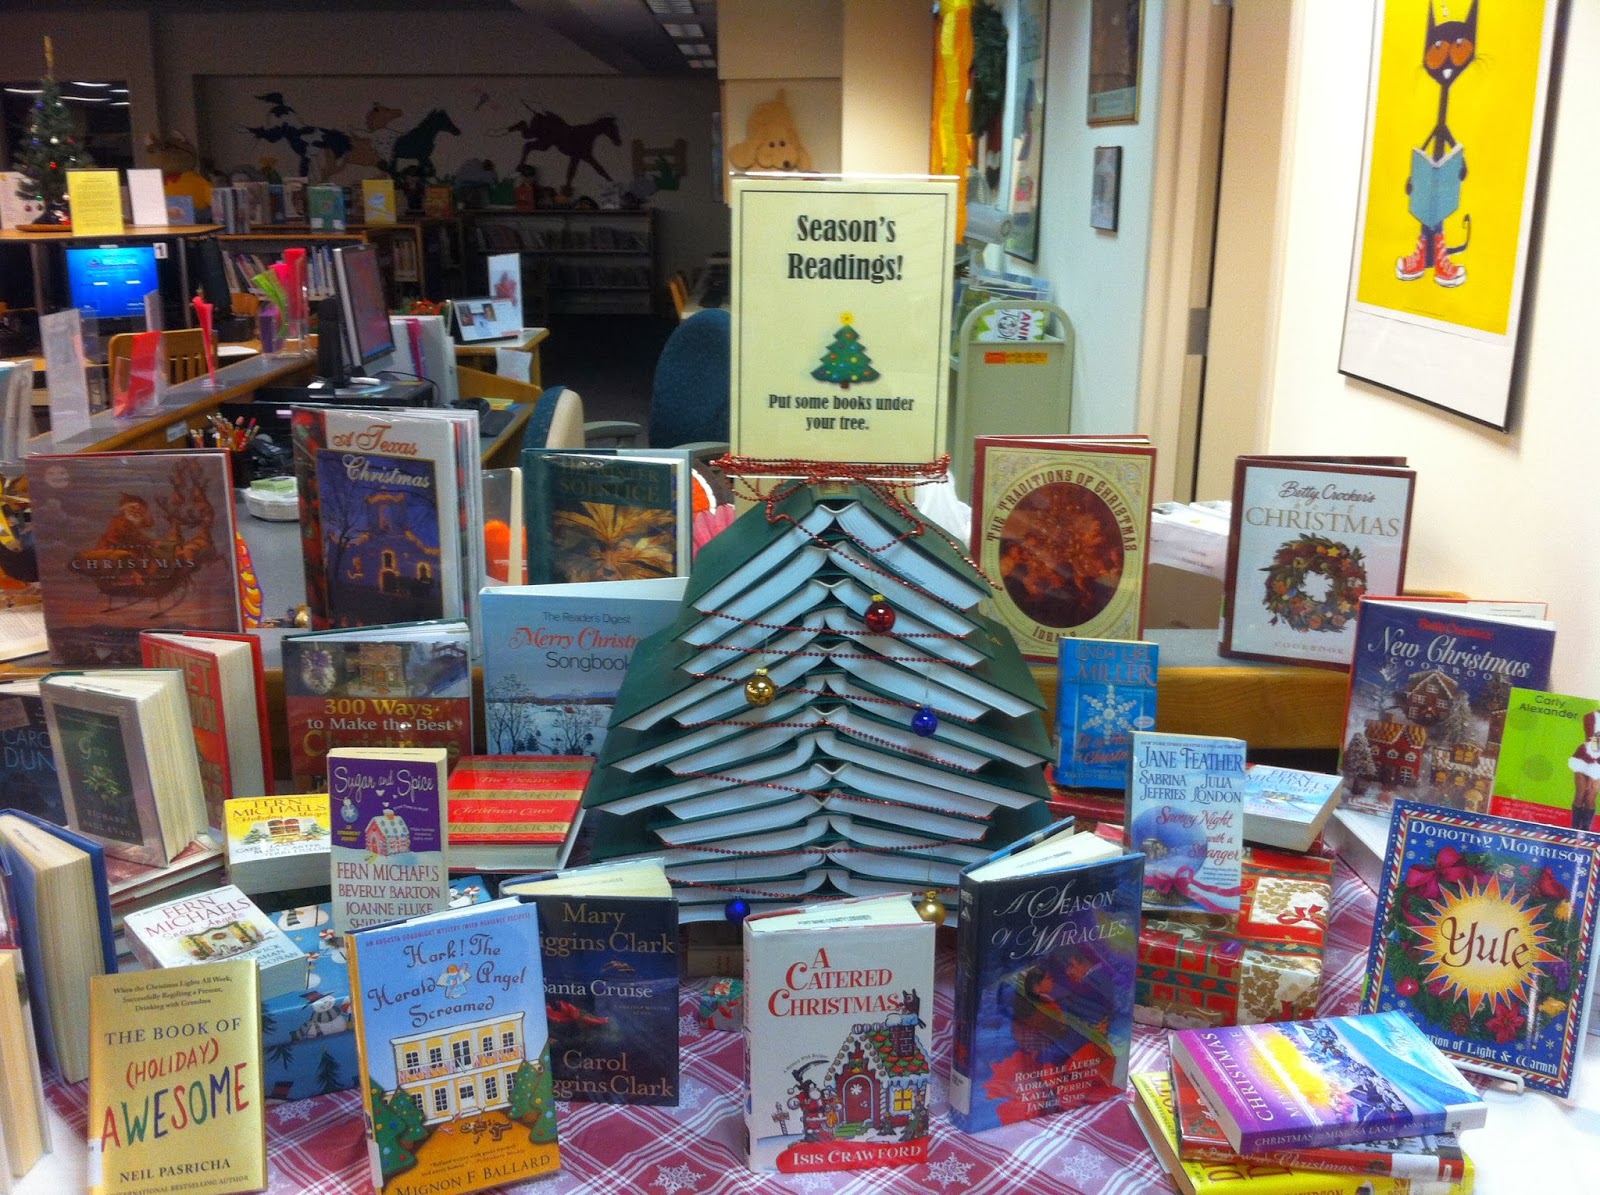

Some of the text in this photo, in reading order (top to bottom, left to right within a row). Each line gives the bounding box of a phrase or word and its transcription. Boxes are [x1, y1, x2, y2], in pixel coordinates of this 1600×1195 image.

[797, 214, 897, 243] Season's
[787, 253, 904, 284] Readings!
[768, 394, 914, 411] Put some books under
[805, 415, 869, 431] your tree.
[332, 424, 418, 455] A Texas
[341, 453, 431, 489] Christmas
[1278, 480, 1320, 506] Betty
[985, 469, 1139, 552] THE TRADITIONS OF CHRISTMAS
[1245, 506, 1400, 537] CHRISTMAS
[71, 557, 196, 570] CHRISTMAS
[543, 611, 560, 622] The
[603, 612, 632, 625] Digest
[508, 626, 642, 651] Merry Christm
[546, 652, 631, 673] Songbook
[1367, 626, 1531, 679] New Christmas
[1075, 663, 1158, 687] MILLER
[324, 698, 433, 720] 300 Ways
[1518, 702, 1579, 720] Alexander
[1534, 694, 1567, 709] Carly
[307, 718, 454, 732] to Make the Best
[2, 728, 52, 749] CARO
[4, 746, 59, 772] DUN
[1139, 746, 1178, 769] JANE
[1180, 747, 1245, 773] FEATHER
[334, 766, 435, 803] Sugar and Spice
[1139, 770, 1188, 787] SABRINA
[1200, 774, 1233, 789] JULIA
[254, 798, 302, 808] FERN
[1139, 784, 1187, 801] JEFFRIES
[1190, 786, 1242, 805] LONDON
[232, 804, 328, 818] MICHAELS
[1156, 805, 1234, 831] Snowy Night
[1206, 832, 1225, 845] with
[1495, 836, 1592, 865] MORRISON
[1188, 842, 1239, 866] Stranger
[337, 861, 440, 882] FERN MICHAELS
[338, 883, 441, 900] BEVERLY BARTON
[992, 890, 1036, 917] A
[1027, 878, 1119, 919] SEASON
[145, 898, 251, 938] MICHAELS
[161, 895, 216, 919] FERN
[345, 901, 434, 917] JOANNE FLUKE
[562, 902, 626, 932] Mary
[349, 917, 394, 929] SHIR
[403, 933, 502, 969] Hark! The
[540, 932, 676, 957] iggins Clark
[1009, 918, 1127, 960] MIRACLES
[1440, 916, 1531, 970] Yule
[811, 947, 831, 969] A
[113, 985, 133, 995] When
[145, 981, 179, 993] Christmas
[180, 979, 200, 990] Lights
[200, 977, 212, 986] All
[212, 975, 233, 985] Work,
[367, 960, 527, 1012] Herald Angel
[541, 977, 654, 999] Santa Cruise
[785, 961, 893, 991] CATERED
[165, 1001, 180, 1010] with
[409, 996, 495, 1028] Screamed
[768, 987, 900, 1018] CHRISTMAS
[104, 1017, 242, 1046] THE BOOK OF
[126, 1037, 220, 1090] (HOLIDAY)
[563, 1049, 628, 1073] Carol
[1452, 1038, 1464, 1052] of
[1467, 1042, 1497, 1061] Light
[1515, 1055, 1559, 1076] Warmth
[1013, 1064, 1067, 1083] ROCHELLE
[1015, 1067, 1098, 1094] ADRIANNE BYRD
[1200, 1031, 1275, 1122] CHRISTMAS
[551, 1074, 675, 1099] ggins Clark
[1020, 1080, 1093, 1103] KAYLA PERRIN
[101, 1062, 250, 1153] AWESOME
[1026, 1092, 1085, 1114] JANICE SIMS
[1254, 1132, 1314, 1147] CHRISTMAS
[1325, 1127, 1367, 1140] MIMOSA
[1368, 1124, 1396, 1135] LANE
[792, 1144, 923, 1166] ISIS CRAWFORD
[1274, 1151, 1356, 1173] Christmas
[120, 1158, 232, 1183] NEIL PASRICHA
[218, 1174, 249, 1186] AUTHOR
[394, 1176, 463, 1195] MIGNON
[482, 1153, 551, 1180] BALLARD
